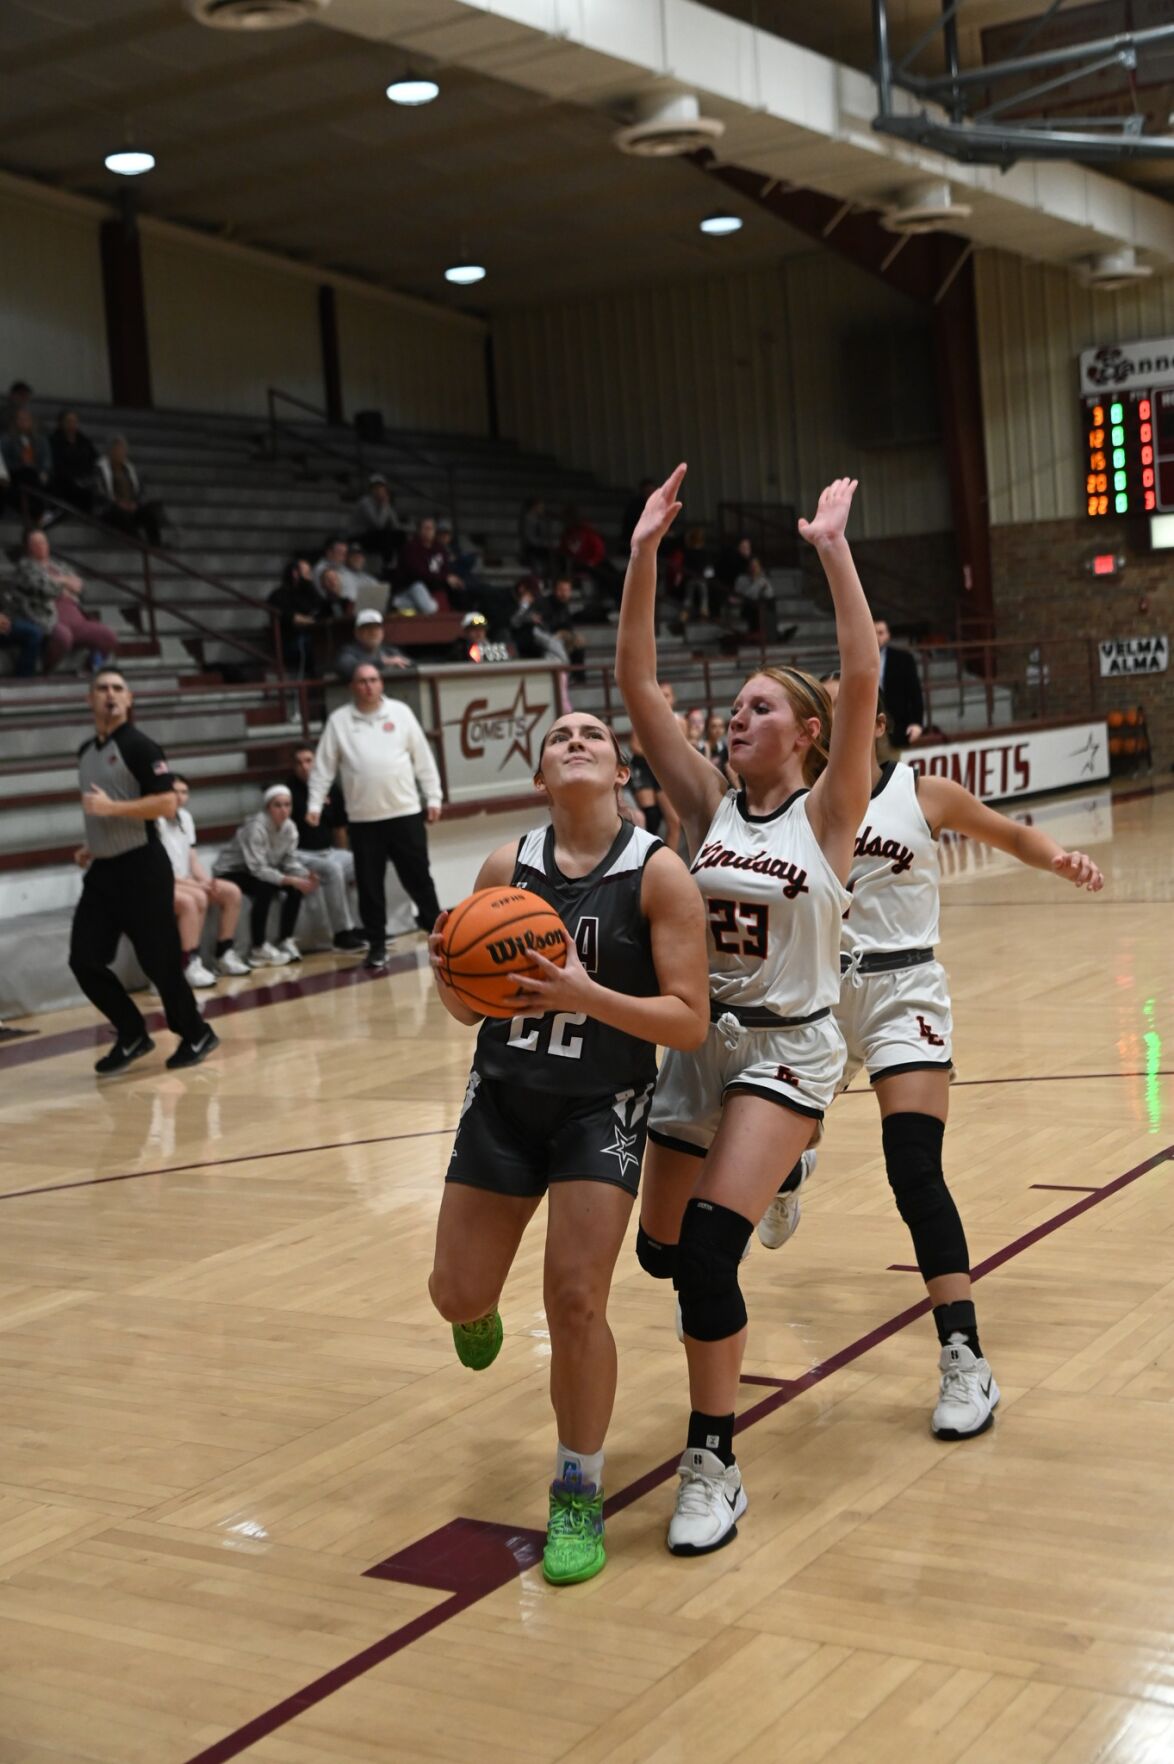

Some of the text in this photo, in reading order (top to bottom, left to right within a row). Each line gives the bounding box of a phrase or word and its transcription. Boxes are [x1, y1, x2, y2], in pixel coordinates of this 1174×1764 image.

[1102, 638, 1165, 658] VELMA
[1109, 655, 1160, 674] ALMA
[461, 698, 526, 760] COMETS
[486, 928, 565, 965] Wilson
[707, 898, 769, 960] 23
